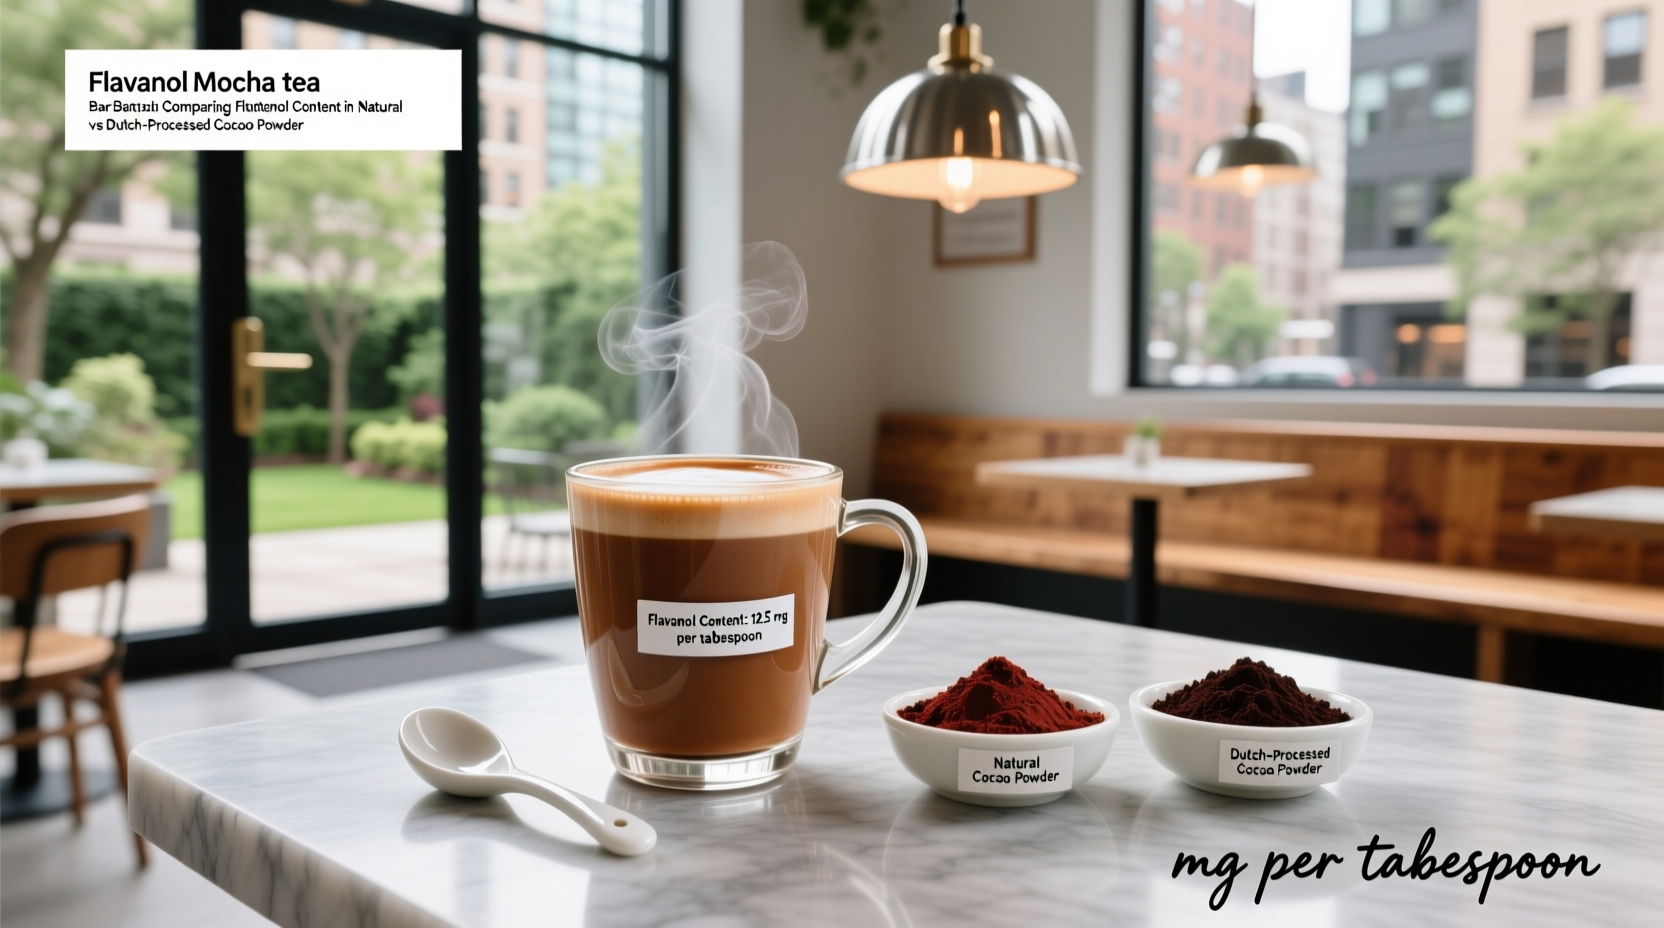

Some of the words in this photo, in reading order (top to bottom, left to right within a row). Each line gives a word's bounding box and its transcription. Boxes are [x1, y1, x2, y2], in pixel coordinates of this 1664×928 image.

[648, 613, 696, 627] Flavanol
[676, 633, 697, 646] per
[700, 630, 762, 645] tabespoon
[1230, 746, 1331, 761] Dutch-Processed
[993, 755, 1040, 770] Natural
[1277, 762, 1323, 776] Powder
[1014, 769, 1060, 784] Powder
